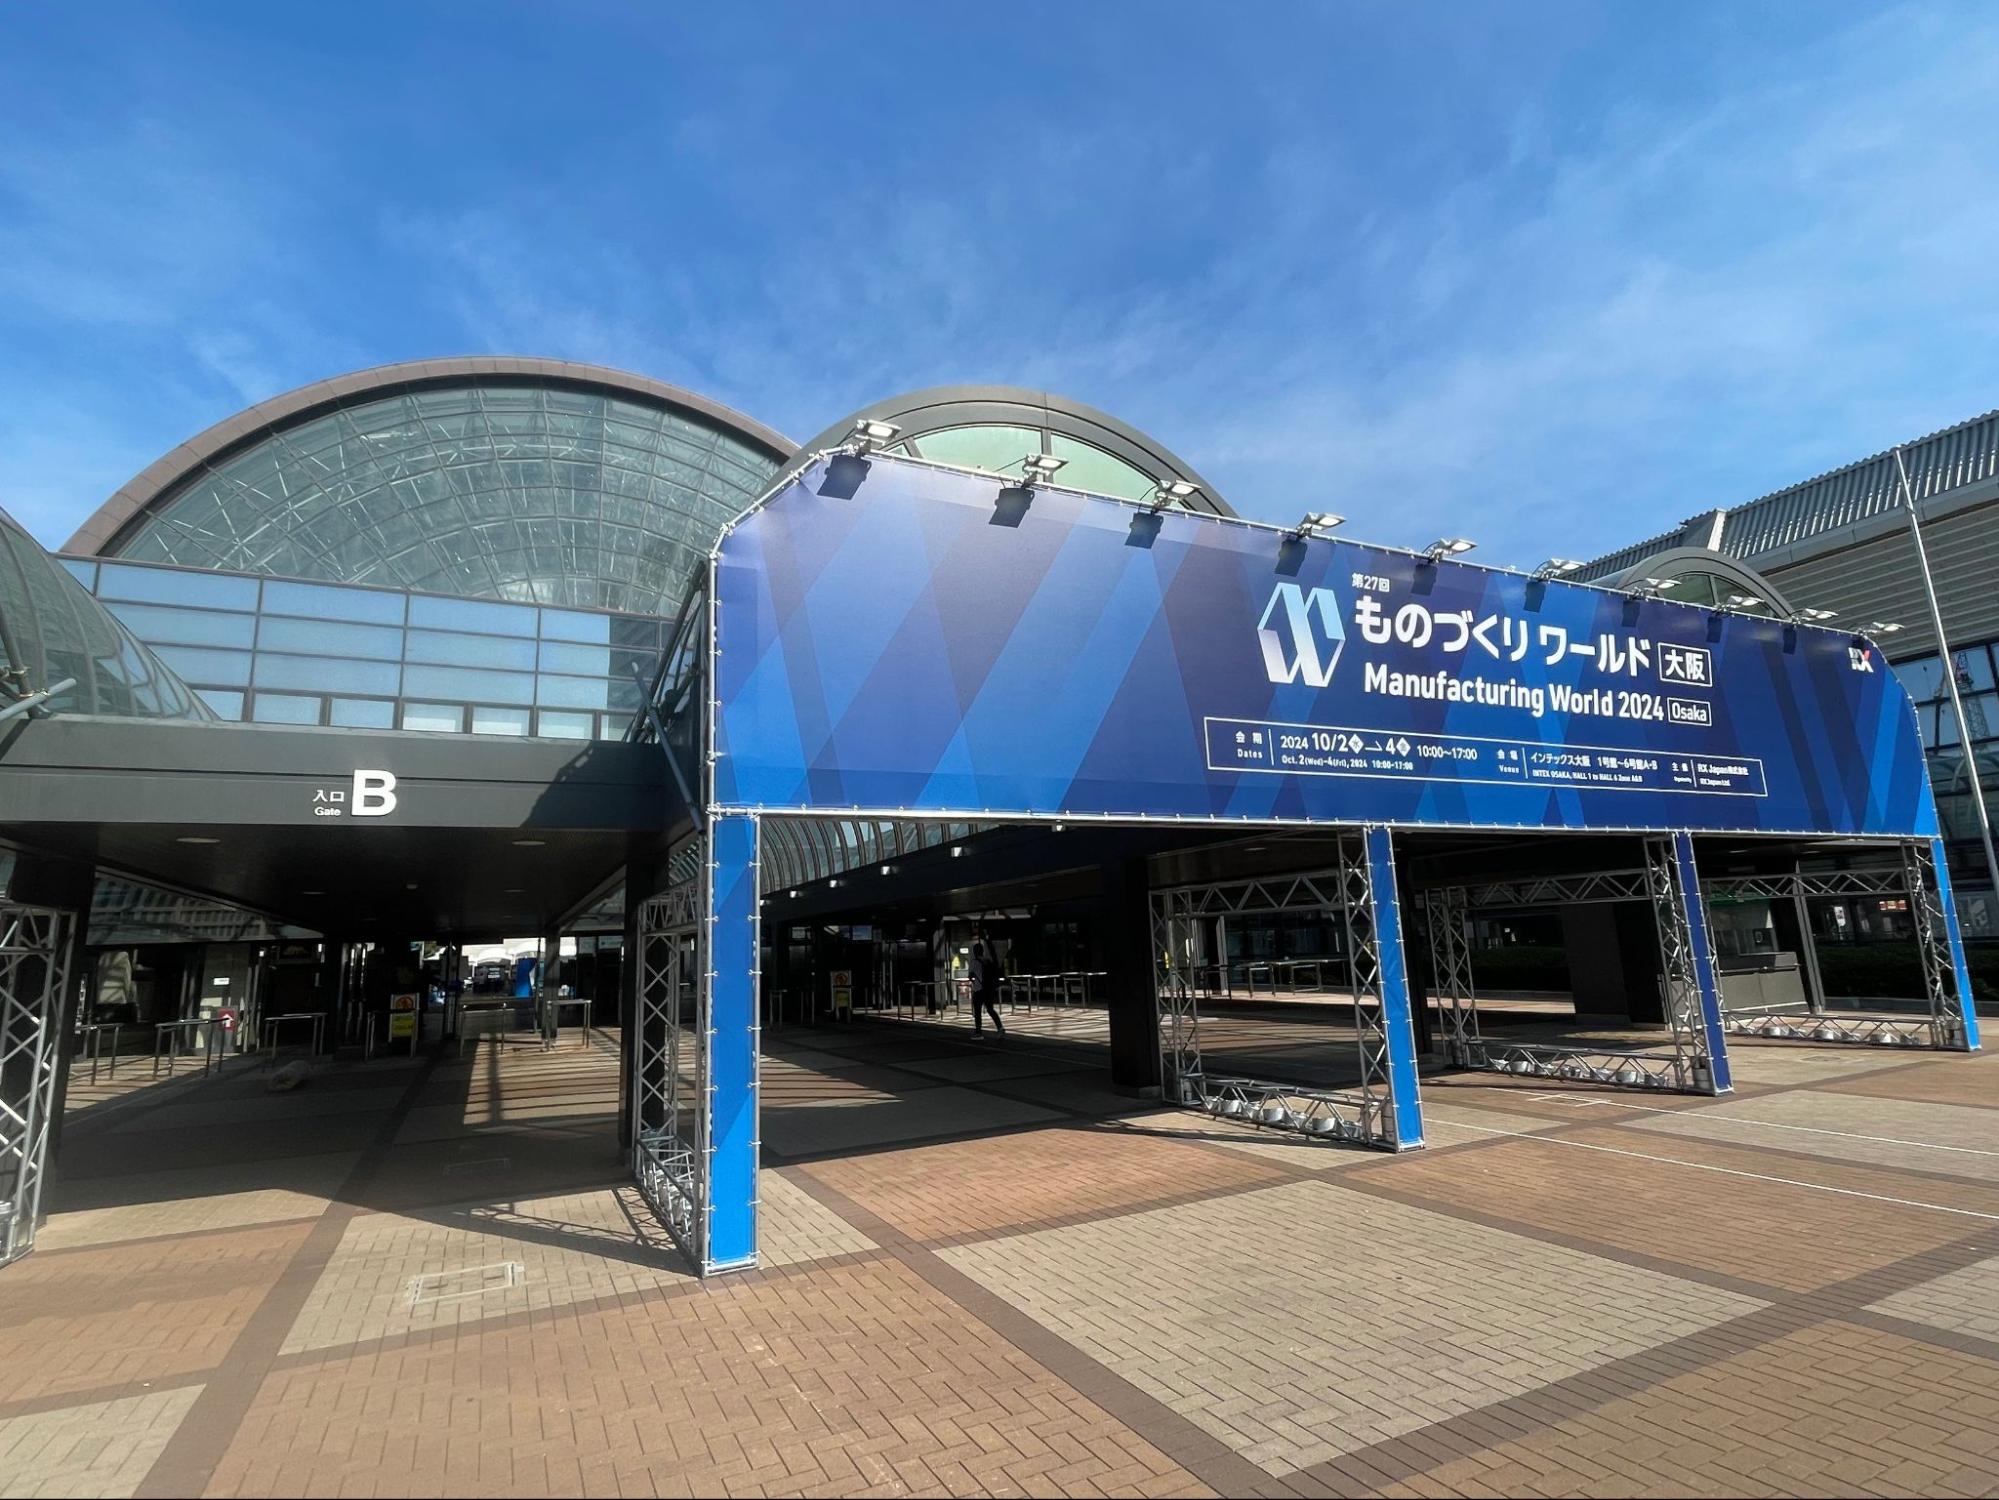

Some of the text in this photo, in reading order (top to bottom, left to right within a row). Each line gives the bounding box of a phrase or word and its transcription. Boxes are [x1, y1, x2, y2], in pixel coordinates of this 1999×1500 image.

[1351, 573, 1390, 593] 第27回
[1354, 595, 1651, 677] ものづくり ワールド
[1664, 648, 1706, 682] 大阪
[1364, 662, 1664, 721] Manufacturing World 2024
[1671, 701, 1707, 723] Osaka
[1235, 731, 1262, 745] 会期
[1280, 735, 1308, 750] 2024
[1311, 732, 1349, 752] 10/2
[1385, 737, 1396, 755] 4
[1237, 748, 1263, 759] Dates
[1281, 754, 1298, 765] Oct.
[1530, 752, 1591, 767] インテックス大阪
[312, 789, 345, 802] 入口
[351, 769, 397, 816] B
[314, 806, 341, 816] Gate
